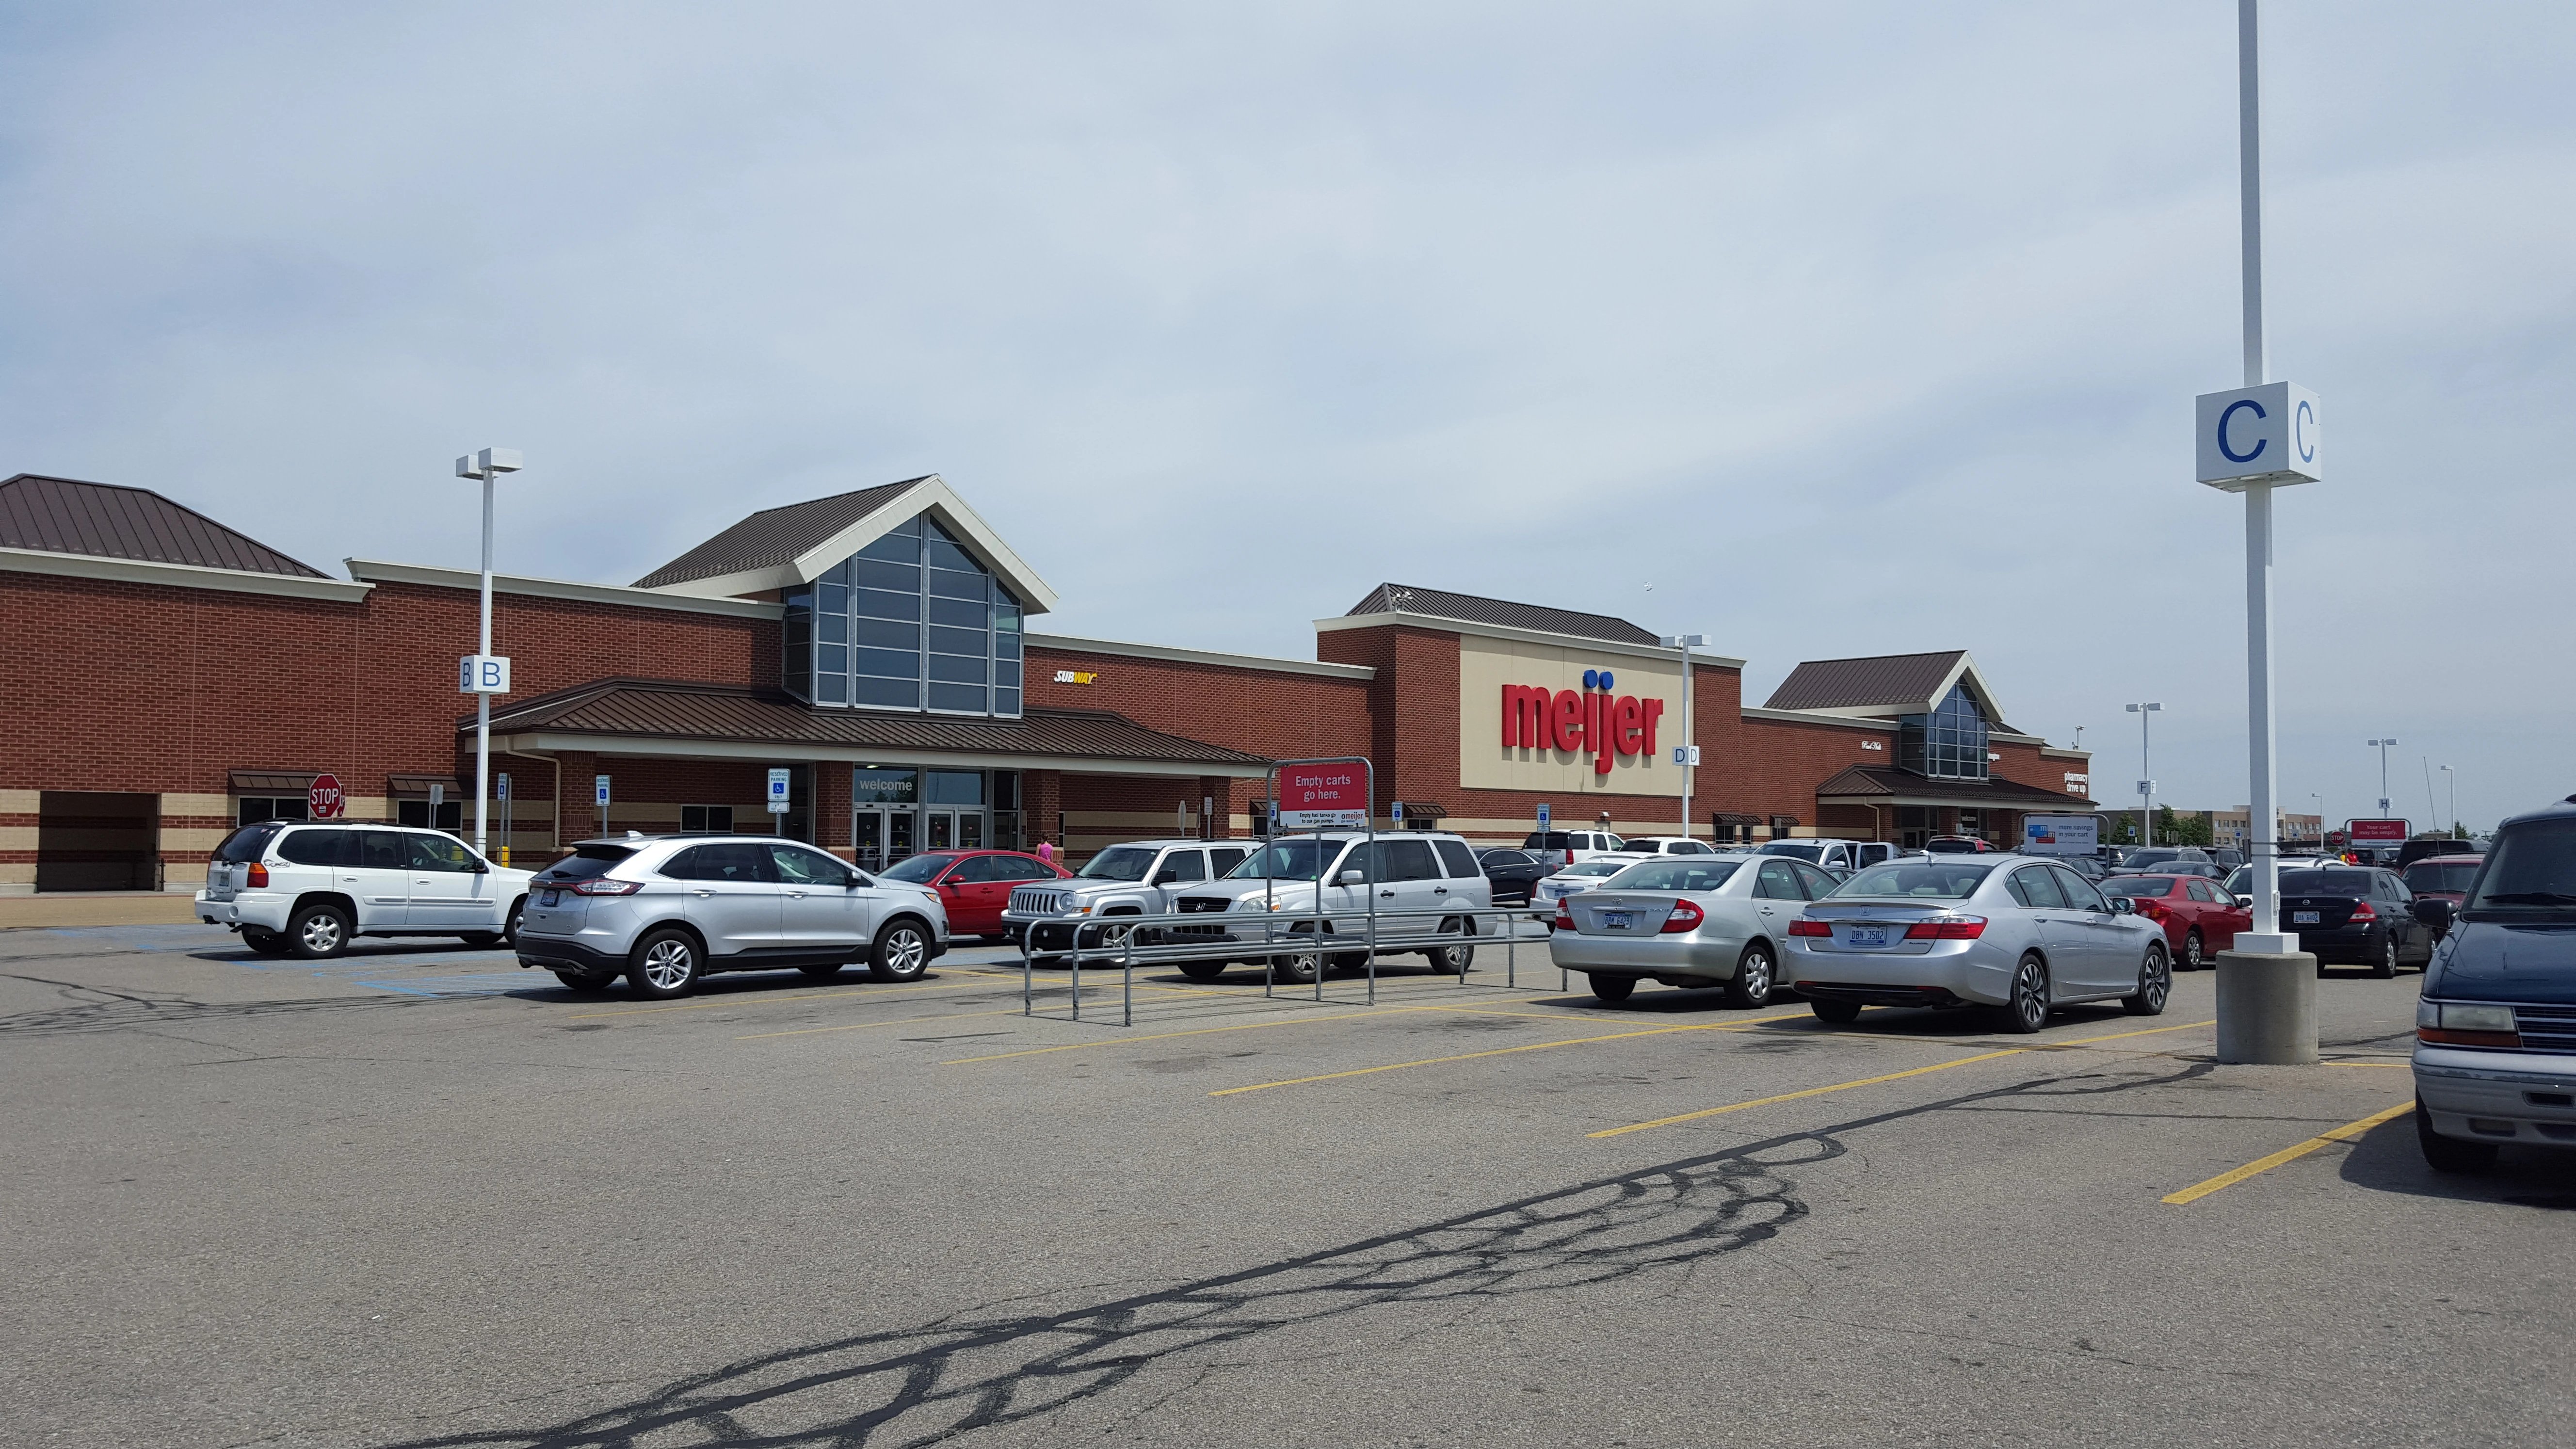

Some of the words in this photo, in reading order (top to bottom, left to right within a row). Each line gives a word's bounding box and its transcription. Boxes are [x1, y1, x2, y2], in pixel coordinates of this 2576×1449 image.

[2218, 400, 2267, 463] C
[2296, 400, 2314, 463] C
[463, 662, 470, 687] B
[483, 662, 500, 686] B
[1053, 670, 1097, 685] SUBWAY
[1501, 669, 1663, 774] meijer
[1675, 749, 1685, 762] D
[1690, 749, 1697, 762] D
[1295, 775, 1323, 788] Empty
[1326, 774, 1351, 785] carts
[2064, 771, 2088, 784] pharmacy
[860, 778, 912, 791] welcome
[2066, 782, 2078, 792] drive
[2079, 785, 2086, 795] up
[2141, 782, 2147, 792] F
[311, 788, 339, 805] STOP
[1304, 790, 1315, 802] go
[1318, 789, 1341, 800] here.
[1617, 917, 1629, 925] 6429
[1868, 931, 1884, 940] 3502
